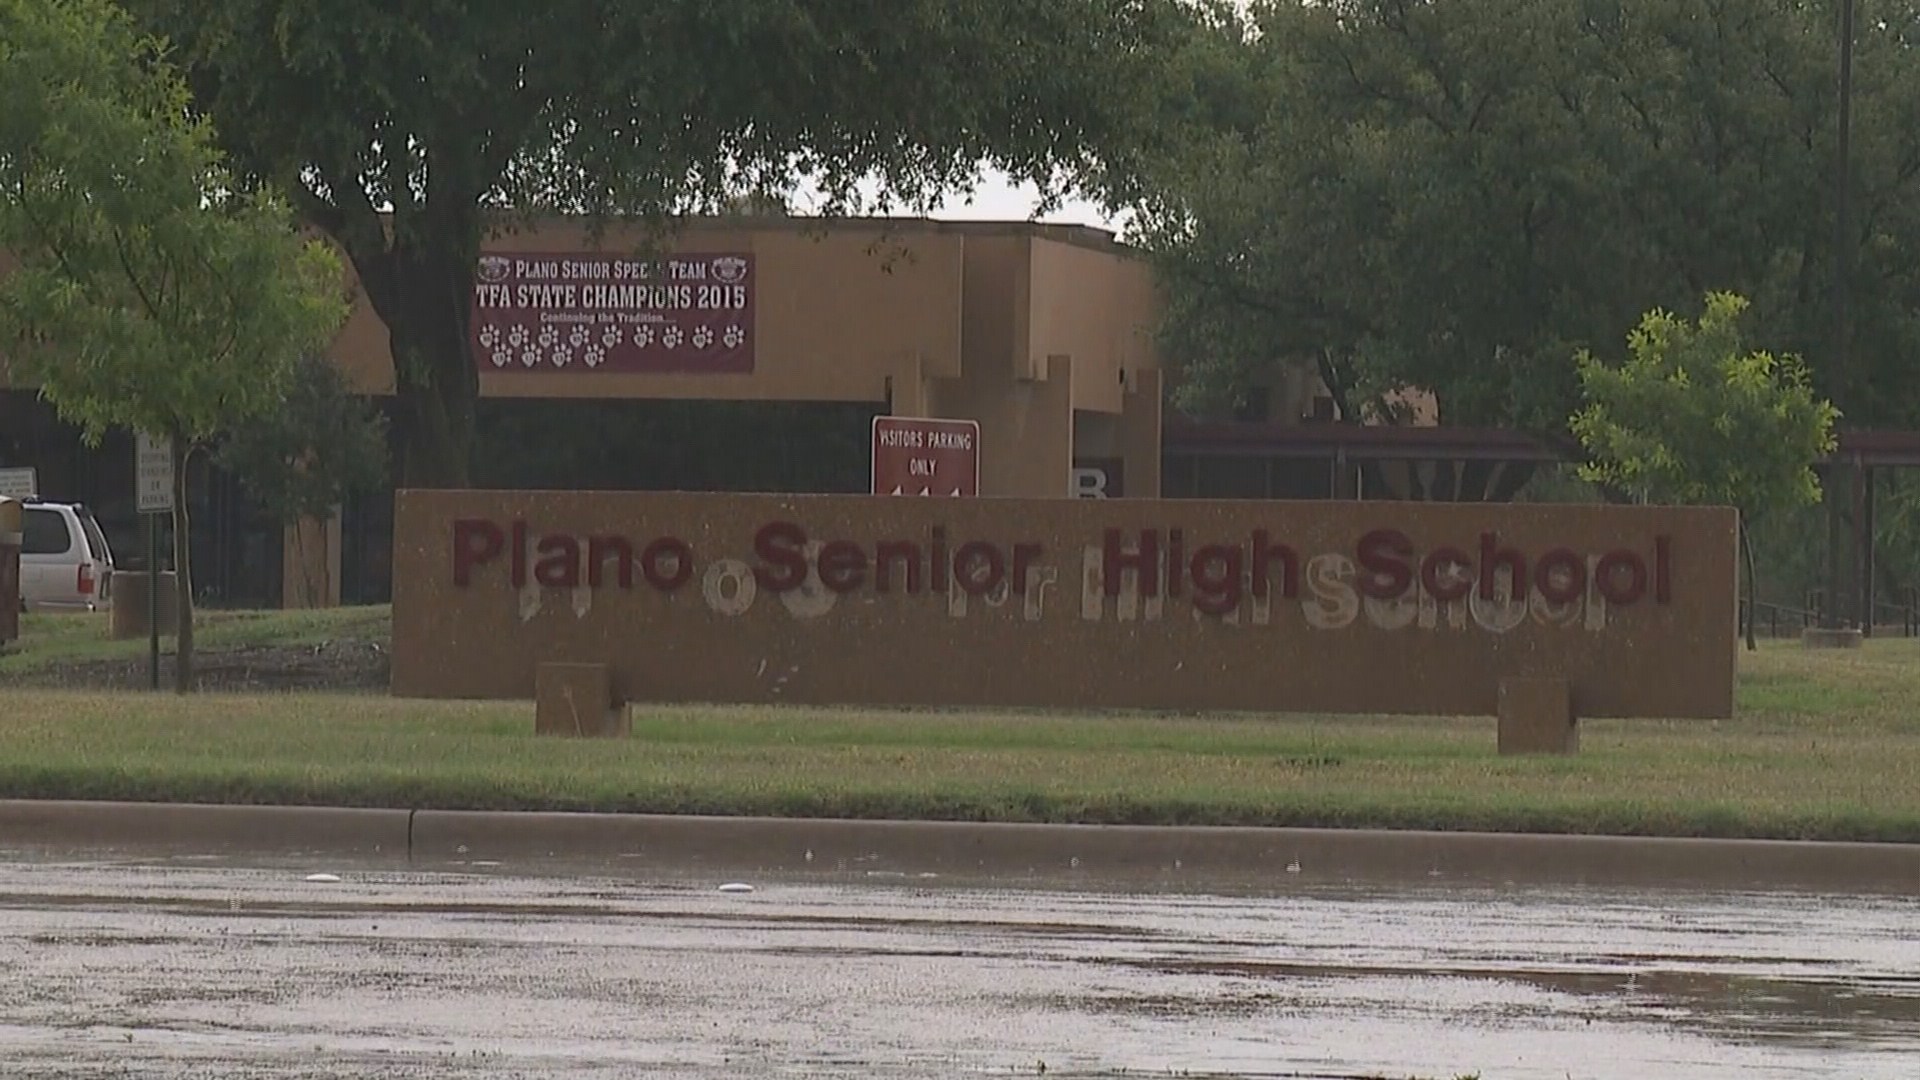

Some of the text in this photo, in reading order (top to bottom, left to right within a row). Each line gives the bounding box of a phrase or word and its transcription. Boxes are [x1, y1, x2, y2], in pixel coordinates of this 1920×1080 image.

[476, 284, 745, 309] TFA STATE CHAMPIONS 2015
[540, 312, 595, 324] Continuing
[598, 312, 615, 323] the
[879, 429, 971, 450] VISITORS PARKING
[910, 458, 938, 477] ONLY
[452, 518, 693, 591] Plano
[753, 521, 1045, 595] Senior
[1102, 527, 1298, 615] High
[1356, 529, 1671, 606] School
